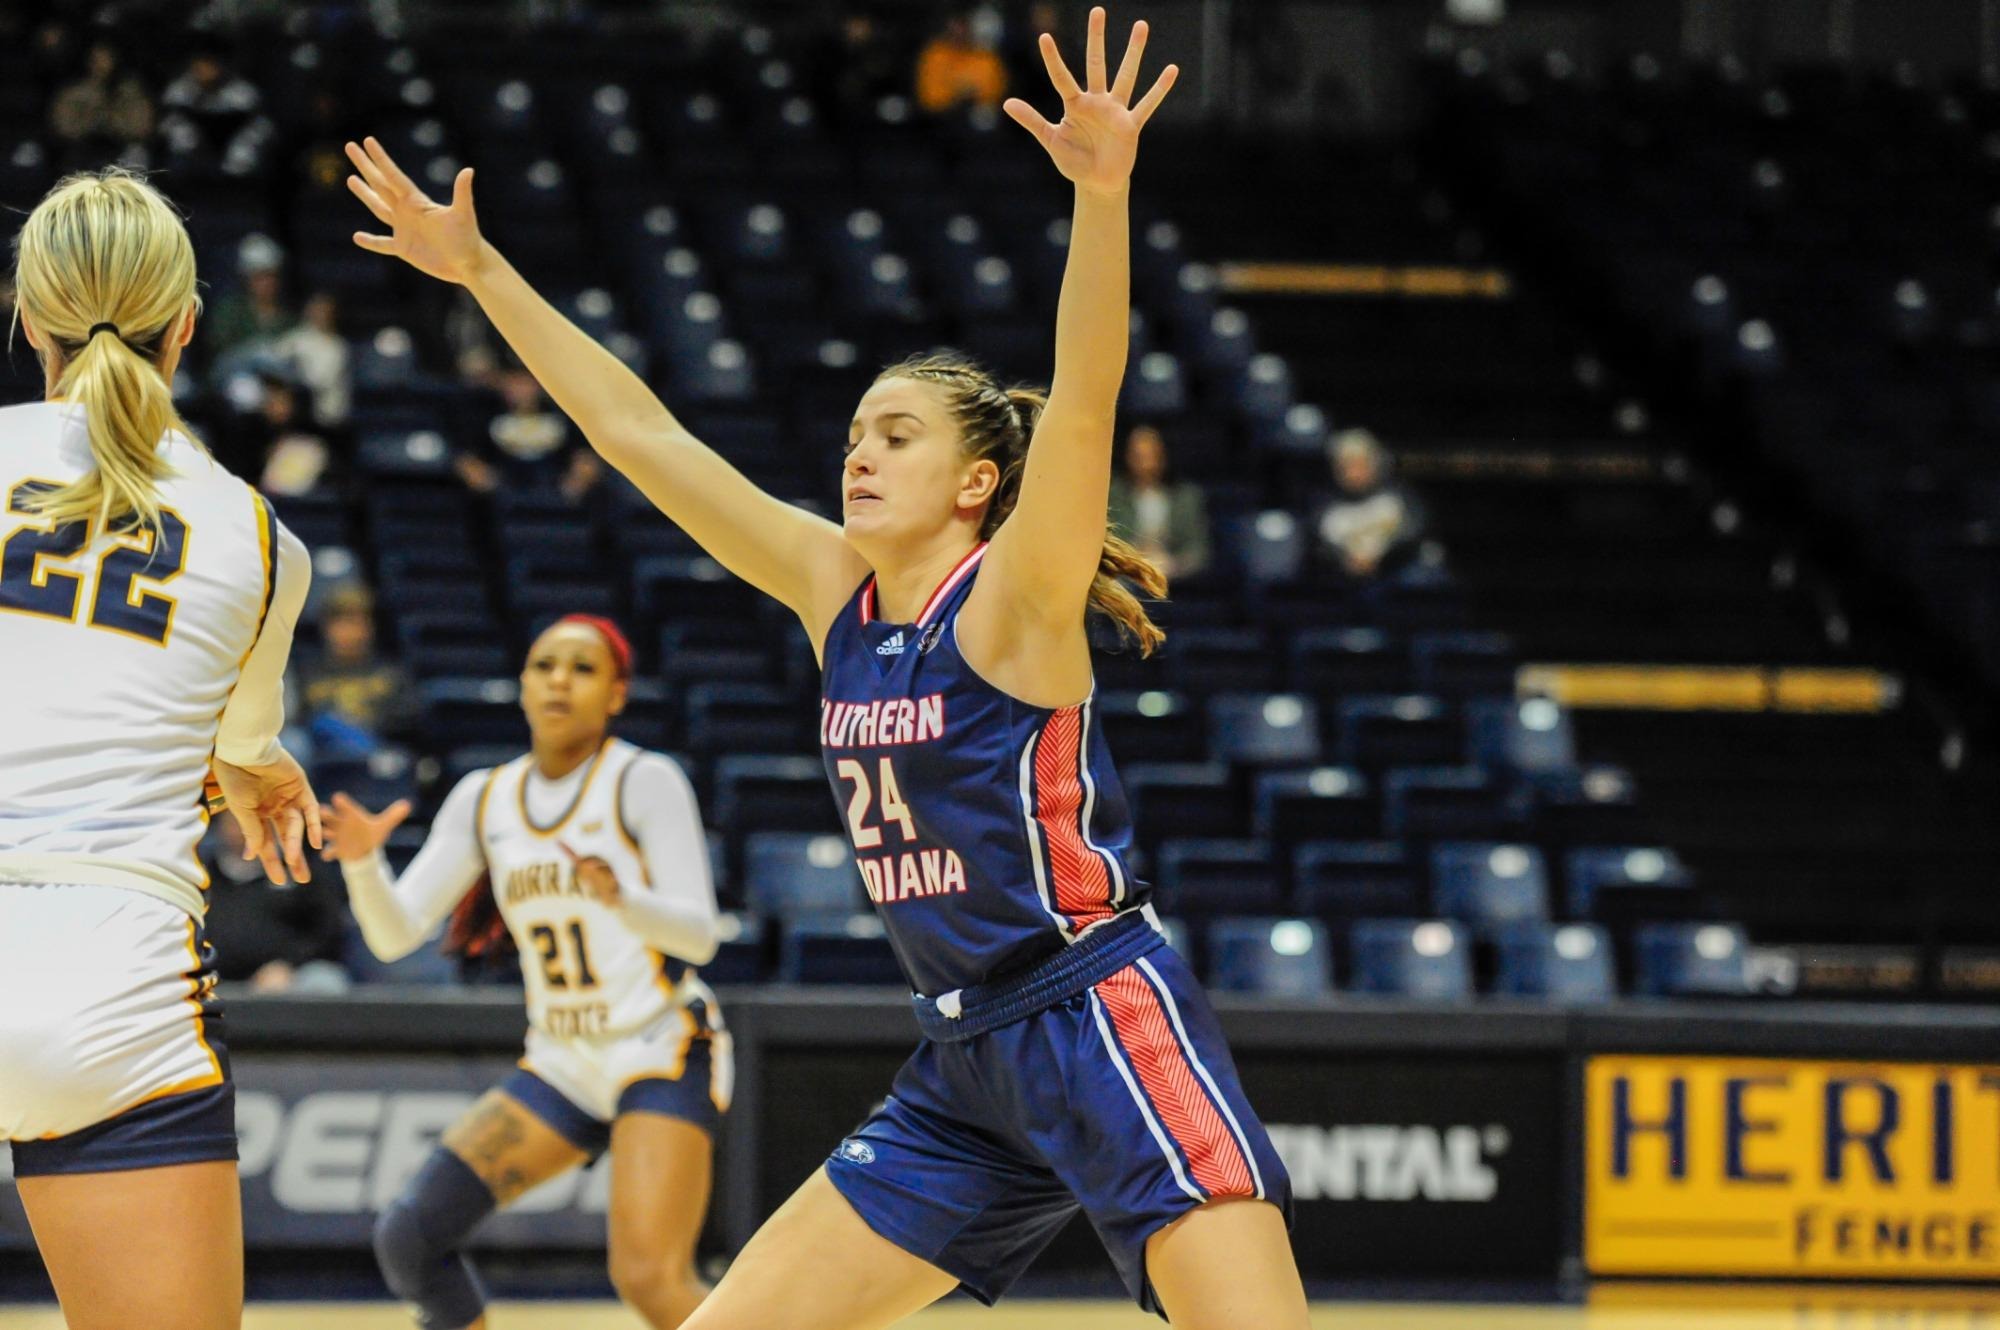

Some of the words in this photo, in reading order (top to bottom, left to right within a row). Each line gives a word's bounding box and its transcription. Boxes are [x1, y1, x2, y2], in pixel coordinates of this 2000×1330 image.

[0, 477, 191, 648] 22
[836, 757, 917, 849] 24
[529, 915, 599, 993] 21
[1611, 1074, 2000, 1184] HERI
